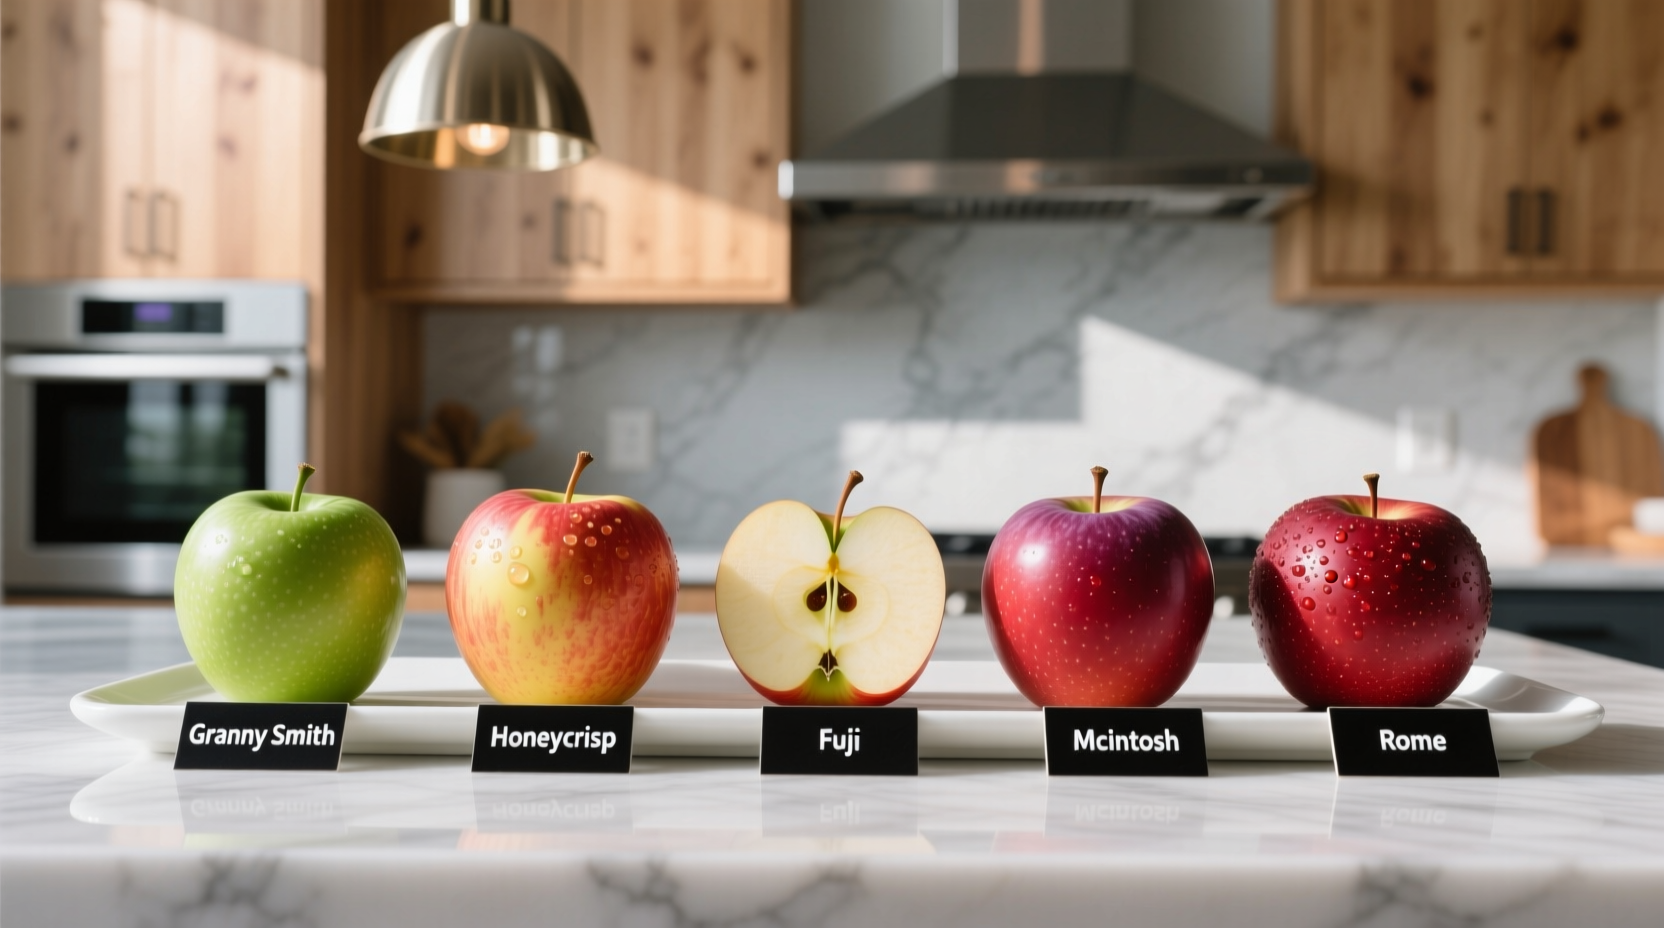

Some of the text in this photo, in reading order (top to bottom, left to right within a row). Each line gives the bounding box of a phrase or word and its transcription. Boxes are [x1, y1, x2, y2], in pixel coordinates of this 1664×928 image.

[188, 723, 336, 752] Granny Smith
[490, 725, 617, 755] Honeycrisp
[819, 727, 861, 756] Fuji
[1073, 728, 1180, 752] Mcintosh
[1379, 728, 1447, 752] Rome
